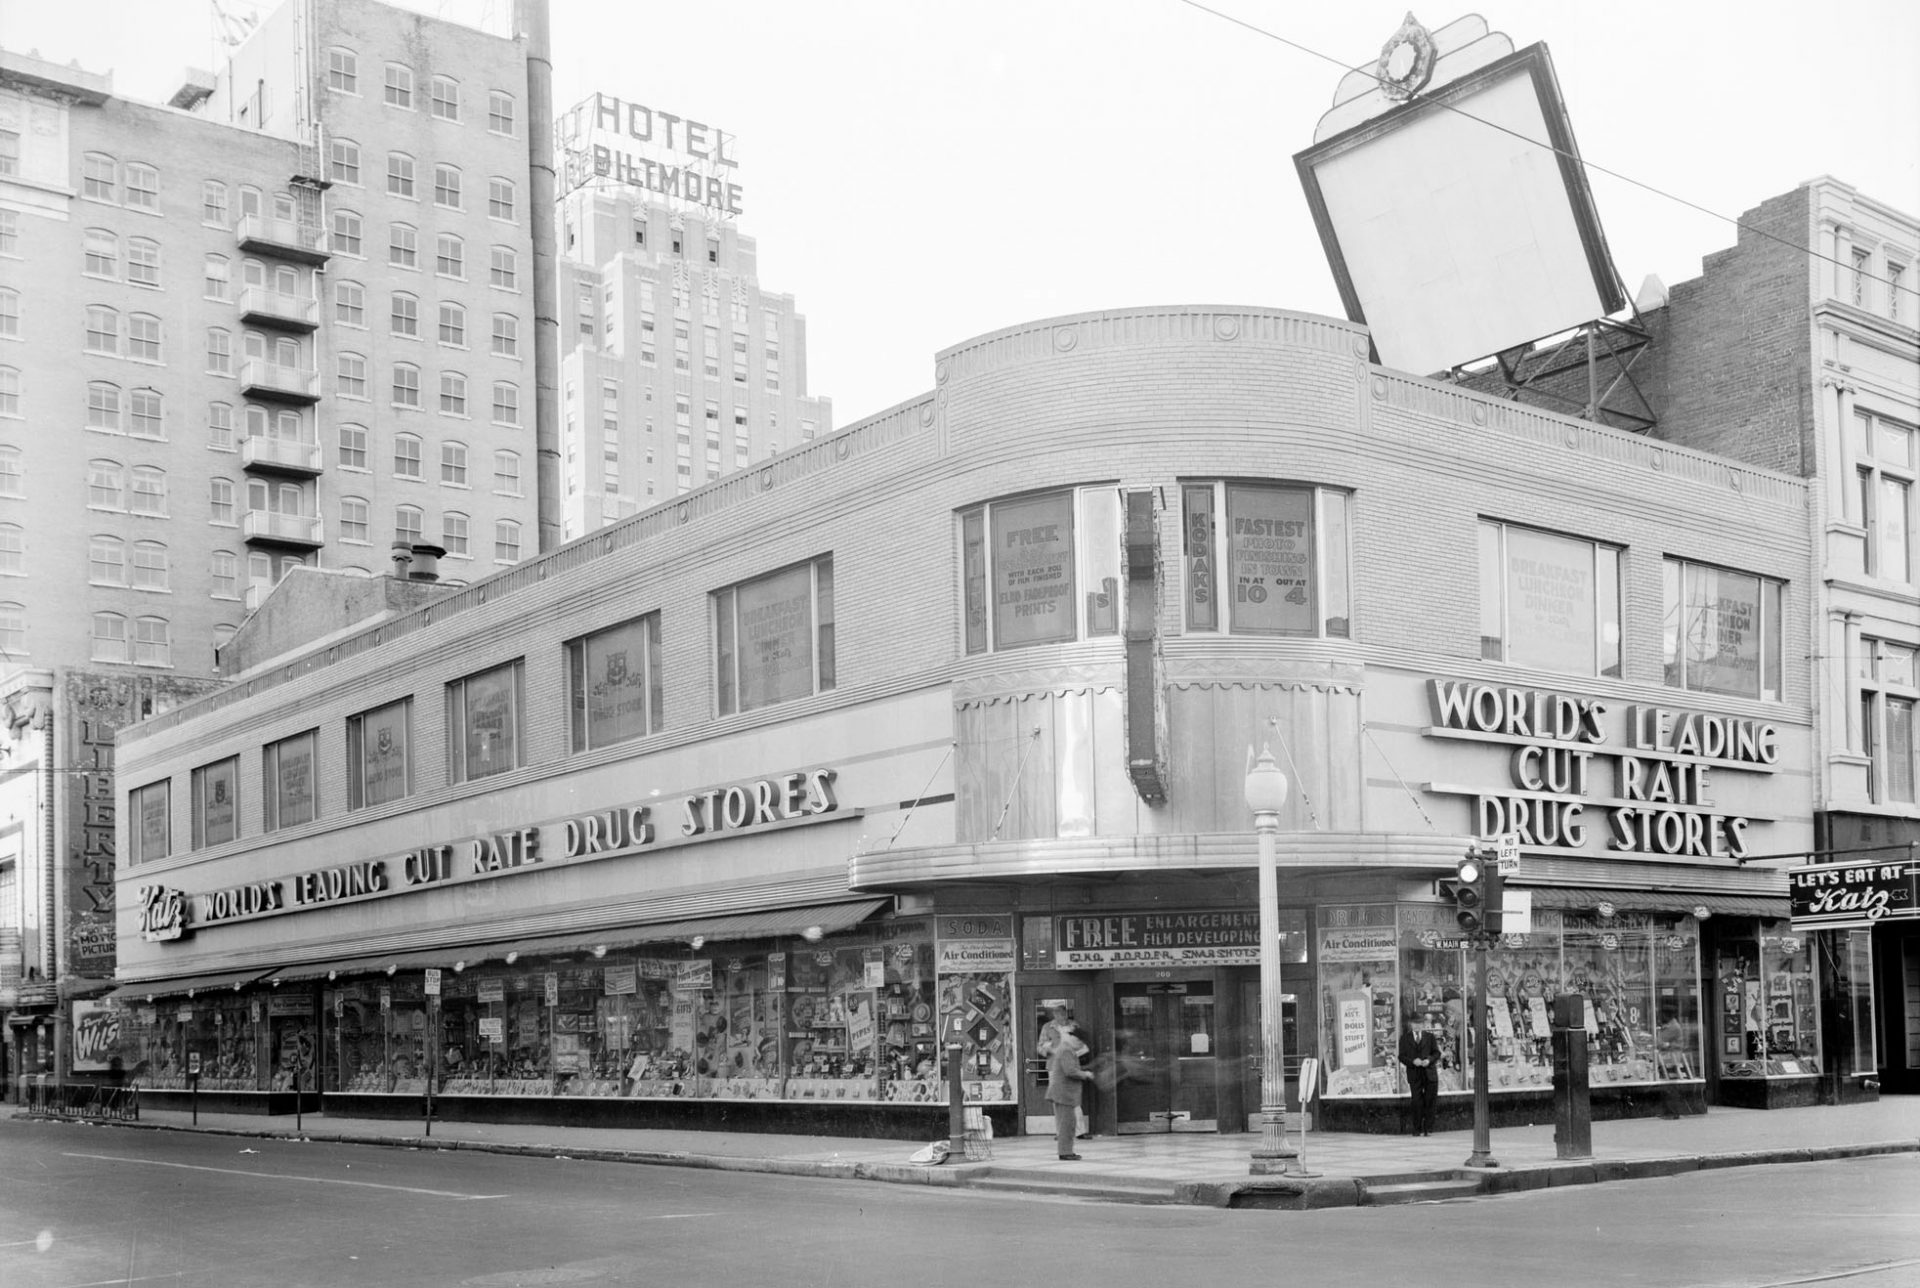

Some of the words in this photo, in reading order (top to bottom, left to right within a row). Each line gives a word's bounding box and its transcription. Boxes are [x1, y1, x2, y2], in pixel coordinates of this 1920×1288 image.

[596, 91, 738, 168] HOTEL
[593, 144, 743, 214] BILTMORE
[1234, 517, 1305, 538] FASTEST
[1006, 524, 1058, 548] FREE
[1242, 537, 1296, 550] PHOTO
[1191, 512, 1209, 604] KODAKS
[1236, 549, 1307, 564] FINISHING
[1008, 570, 1025, 580] WITH
[1027, 567, 1045, 576] EACH
[1240, 563, 1253, 575] IN
[1263, 564, 1303, 577] TOWN
[1511, 556, 1587, 585] BREAKFAST
[1007, 578, 1016, 587] OF
[1017, 576, 1031, 585] FILM
[1033, 571, 1062, 583] FINISHED
[1239, 576, 1251, 585] IN
[1252, 577, 1265, 585] AT
[1275, 578, 1294, 587] OUT
[1295, 579, 1307, 587] AT
[1237, 584, 1268, 604] 10
[1284, 586, 1308, 606] 4
[1014, 600, 1057, 618] PRINTS
[1428, 679, 1608, 744] WORLD'S
[1630, 705, 1780, 765] LEADING
[1513, 745, 1595, 797] CUT
[1618, 755, 1716, 808] RATE
[1475, 795, 1588, 848] DRUG
[1610, 808, 1751, 860] STORES
[1504, 837, 1514, 846] NO
[137, 884, 187, 940] Katz
[203, 882, 282, 921] WORLD'S
[293, 861, 386, 906] LEADING
[403, 844, 452, 885] CUT
[472, 827, 540, 874] RATE
[564, 806, 653, 858] DRUG
[681, 768, 837, 836] STORES
[1500, 848, 1518, 858] LEFT
[1500, 860, 1518, 870] TURN
[1797, 870, 1840, 888] LET'S
[1844, 868, 1876, 883] EAT
[1880, 865, 1903, 880] AT
[1809, 886, 1891, 919] Katz
[949, 919, 1003, 936] SODA
[1066, 917, 1138, 949] FREE
[1143, 932, 1172, 946] FILM
[1324, 939, 1340, 950] Air
[1341, 938, 1396, 950] Conditioned
[1443, 940, 1459, 949] MAIN
[943, 950, 960, 961] Air
[961, 949, 1014, 960] Conditioned
[1155, 970, 1171, 978] 200
[676, 1003, 692, 1014] GIFTS
[852, 1026, 871, 1041] PIPES
[1344, 1022, 1365, 1030] DOLLS
